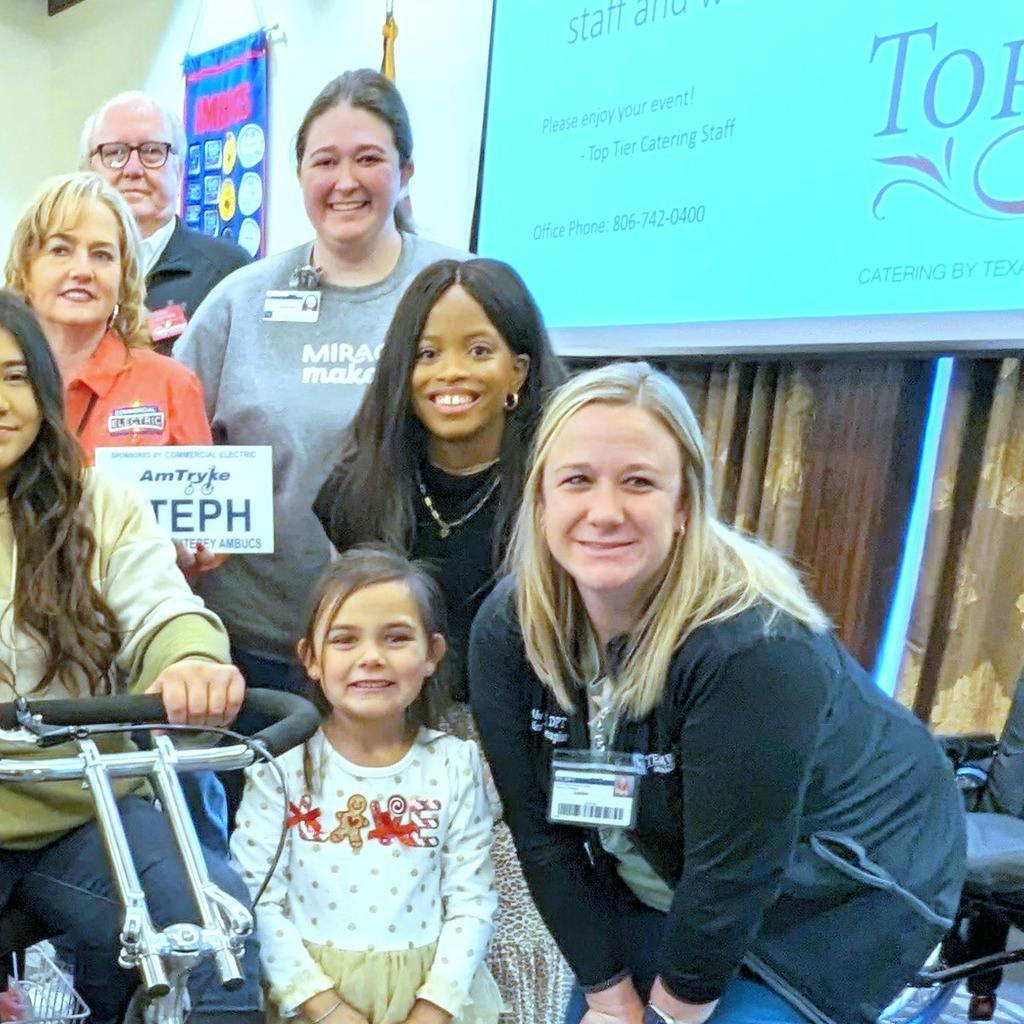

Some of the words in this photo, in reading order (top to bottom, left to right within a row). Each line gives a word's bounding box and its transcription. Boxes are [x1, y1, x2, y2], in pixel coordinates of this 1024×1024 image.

[567, 0, 627, 45] staff
[541, 115, 578, 135] Please
[581, 107, 615, 128] enjoy
[617, 100, 648, 123] your
[650, 86, 695, 113] event!
[588, 144, 609, 163] Top
[613, 139, 637, 158] Tier
[640, 129, 698, 153] Catering
[700, 118, 737, 144] Staff
[533, 221, 566, 241] Office
[568, 217, 609, 237] Phone:
[612, 204, 706, 232] 806-742-0400
[858, 263, 947, 285] CATERING
[951, 261, 978, 280] BY
[165, 451, 217, 459] COMMERCIAL
[219, 451, 257, 459] ELECTRIC
[138, 465, 232, 485] AmTryke
[150, 498, 252, 533] TEPH
[218, 537, 263, 550] AMBUCS
